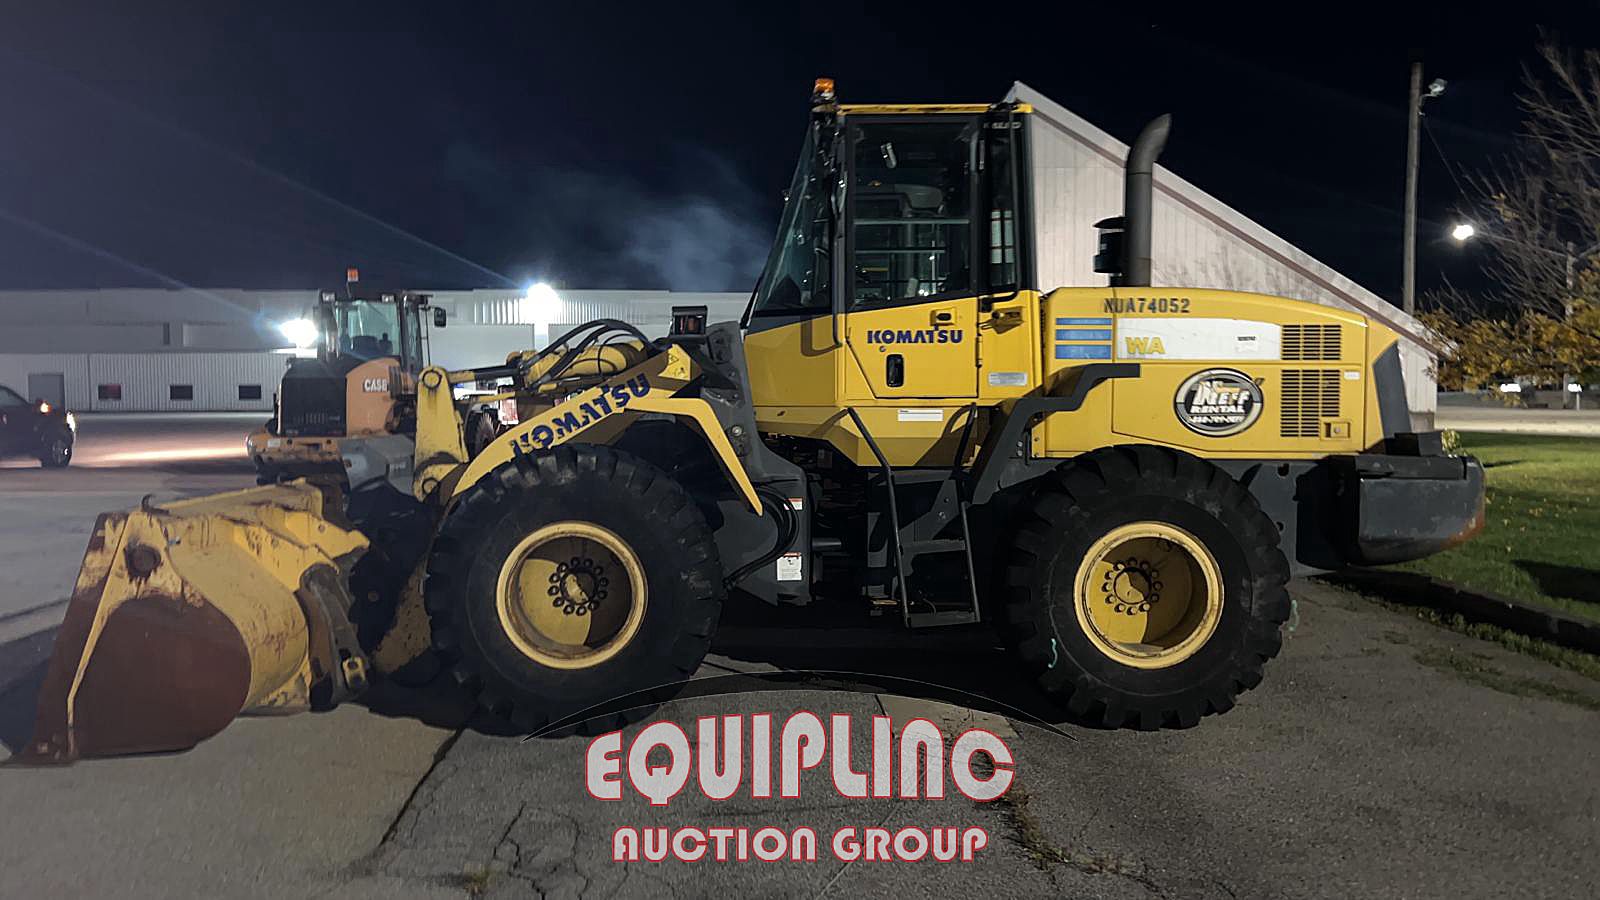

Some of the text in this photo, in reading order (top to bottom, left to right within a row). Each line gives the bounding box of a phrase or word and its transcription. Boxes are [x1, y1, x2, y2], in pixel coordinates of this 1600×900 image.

[867, 325, 963, 344] KOMATSU
[1125, 336, 1165, 354] WA
[364, 378, 388, 392] CASE
[510, 372, 650, 456] KOMATSU
